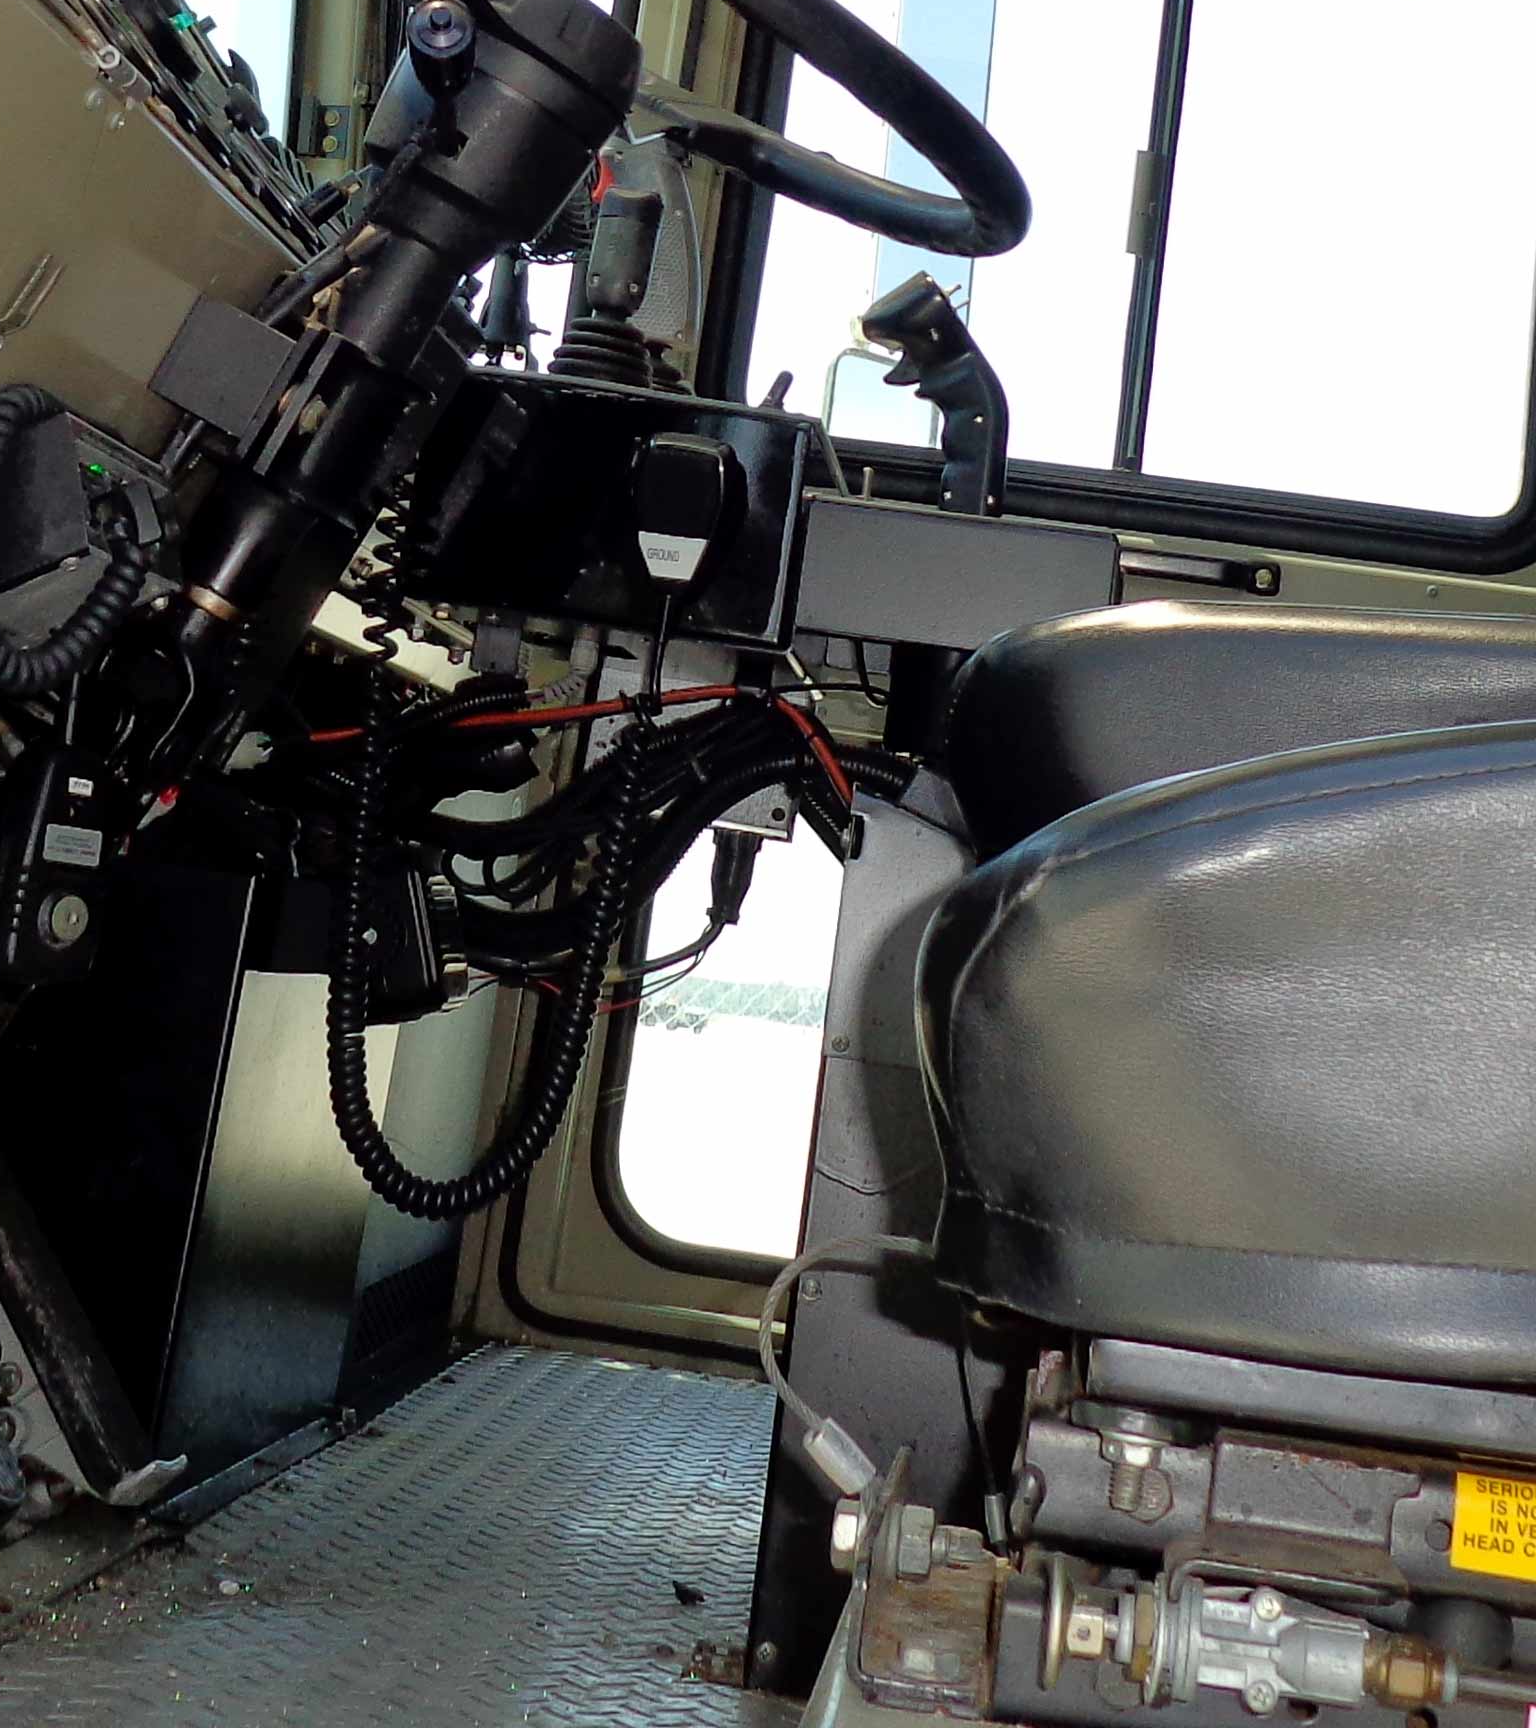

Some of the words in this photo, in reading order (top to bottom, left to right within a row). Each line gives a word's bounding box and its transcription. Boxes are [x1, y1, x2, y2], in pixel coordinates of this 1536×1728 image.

[647, 547, 680, 562] GROUND
[1490, 1499, 1508, 1516] IS
[1490, 1518, 1509, 1535] IN
[1463, 1532, 1515, 1555] HEAD
